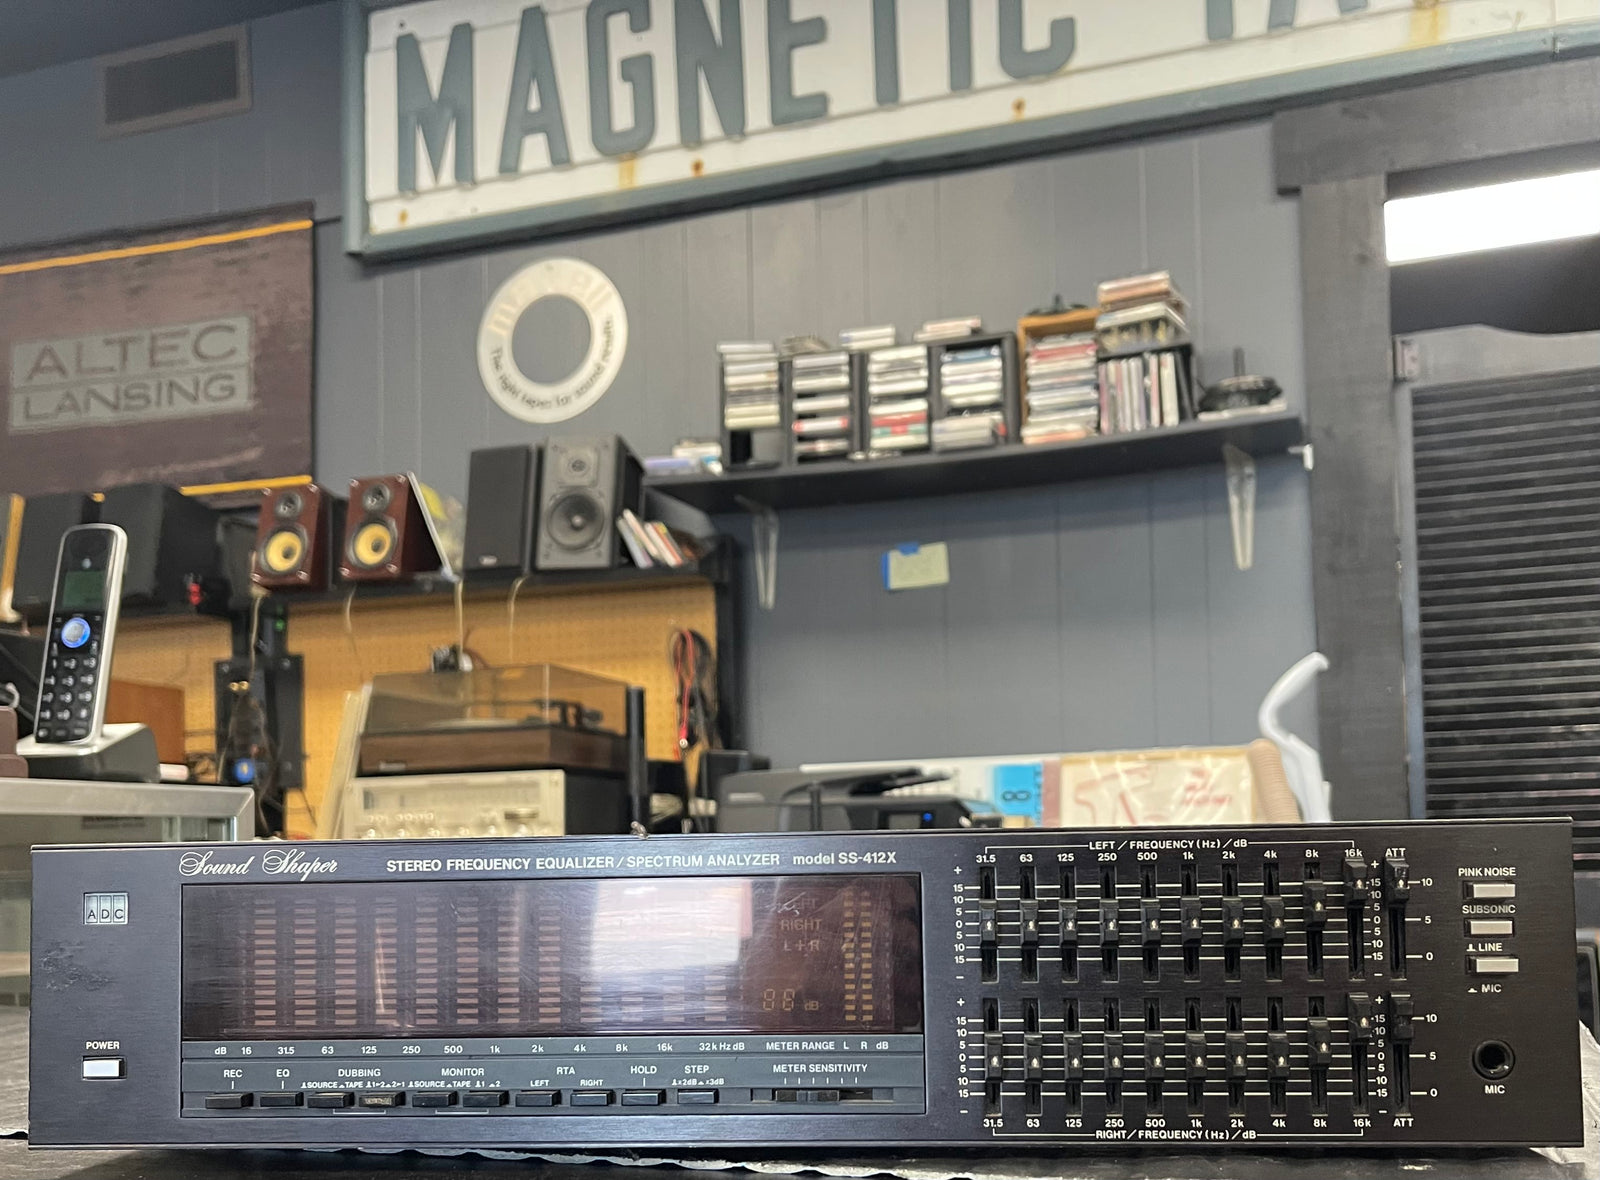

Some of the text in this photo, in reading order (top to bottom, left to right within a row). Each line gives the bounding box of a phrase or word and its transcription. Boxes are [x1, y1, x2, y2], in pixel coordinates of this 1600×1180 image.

[26, 324, 237, 381] ALTEC
[25, 374, 236, 421] LANSING
[556, 395, 571, 407] for
[1089, 840, 1115, 850] LEFT
[976, 847, 1406, 863] 31.5 63 125 250 500 1k 2k 4k 8k 16k ATT
[179, 849, 338, 882] Sound Shaper
[386, 859, 442, 873] STEREO
[446, 858, 531, 871] FREQUENCY
[706, 854, 780, 867] ANALYZER
[792, 852, 835, 865] model
[838, 851, 897, 864] SS-412X
[1458, 867, 1516, 876] PINK NOISE
[1371, 878, 1381, 887] 15
[1421, 878, 1433, 887] 10
[953, 884, 963, 893] 15
[1371, 890, 1382, 899] 10
[953, 895, 963, 904] 10
[1373, 903, 1381, 911] 5
[1462, 904, 1516, 914] SUBSONIC
[87, 908, 124, 920] ADC
[956, 908, 962, 916] 5
[956, 919, 963, 928] 0
[1373, 915, 1381, 924] 0
[1425, 915, 1432, 924] 5
[780, 918, 822, 931] RIGHT
[956, 931, 963, 940] 5
[1374, 927, 1381, 936] 5
[954, 943, 965, 952] 10
[1372, 939, 1383, 948] 10
[1478, 943, 1502, 952] LINE
[955, 955, 965, 964] 15
[1372, 952, 1383, 961] 15
[1426, 952, 1433, 961] 0
[1481, 984, 1502, 993] MIC
[956, 1016, 967, 1025] 15
[1374, 1014, 1386, 1023] 15
[1425, 1014, 1438, 1023] 10
[956, 1028, 967, 1037] 10
[1375, 1027, 1386, 1035] 10
[85, 1040, 120, 1051] POWER
[766, 1041, 889, 1050] METER RANGE L R dB
[959, 1040, 966, 1049] 5
[1377, 1039, 1385, 1048] 5
[214, 1046, 227, 1055] dB
[241, 1046, 252, 1055] 16
[321, 1046, 334, 1054] 63
[361, 1045, 377, 1054] 125
[402, 1045, 421, 1054] 250
[443, 1045, 463, 1053] 500
[490, 1045, 500, 1053] 1k
[531, 1044, 544, 1053] 2k
[573, 1044, 587, 1052] 4k
[615, 1044, 628, 1052] 8k
[656, 1043, 673, 1051] 16k
[732, 1042, 745, 1051] dB
[958, 1053, 966, 1061] 0
[1377, 1052, 1385, 1061] 0
[1429, 1052, 1437, 1061] 5
[338, 1068, 381, 1077] DUBBING
[441, 1068, 485, 1077] MONITOR
[556, 1066, 576, 1076] RTA
[630, 1065, 658, 1075] HOLD
[684, 1064, 710, 1074] STEP
[773, 1063, 868, 1073] METER SENSITIVITY
[960, 1064, 967, 1073] 5
[1378, 1064, 1385, 1073] 5
[223, 1069, 243, 1078] REC
[276, 1068, 290, 1078] EQ
[344, 1081, 363, 1089] TAPE
[530, 1079, 604, 1088] LEFT RIGHT
[957, 1076, 969, 1085] 10
[1375, 1076, 1388, 1085] 10
[958, 1089, 969, 1098] 15
[1376, 1089, 1388, 1098] 15
[1430, 1089, 1438, 1098] 0
[1484, 1085, 1505, 1094] MIC
[983, 1118, 1414, 1128] 31.5 63 125 250 500 1k 2k 4k 8k 16k ATT
